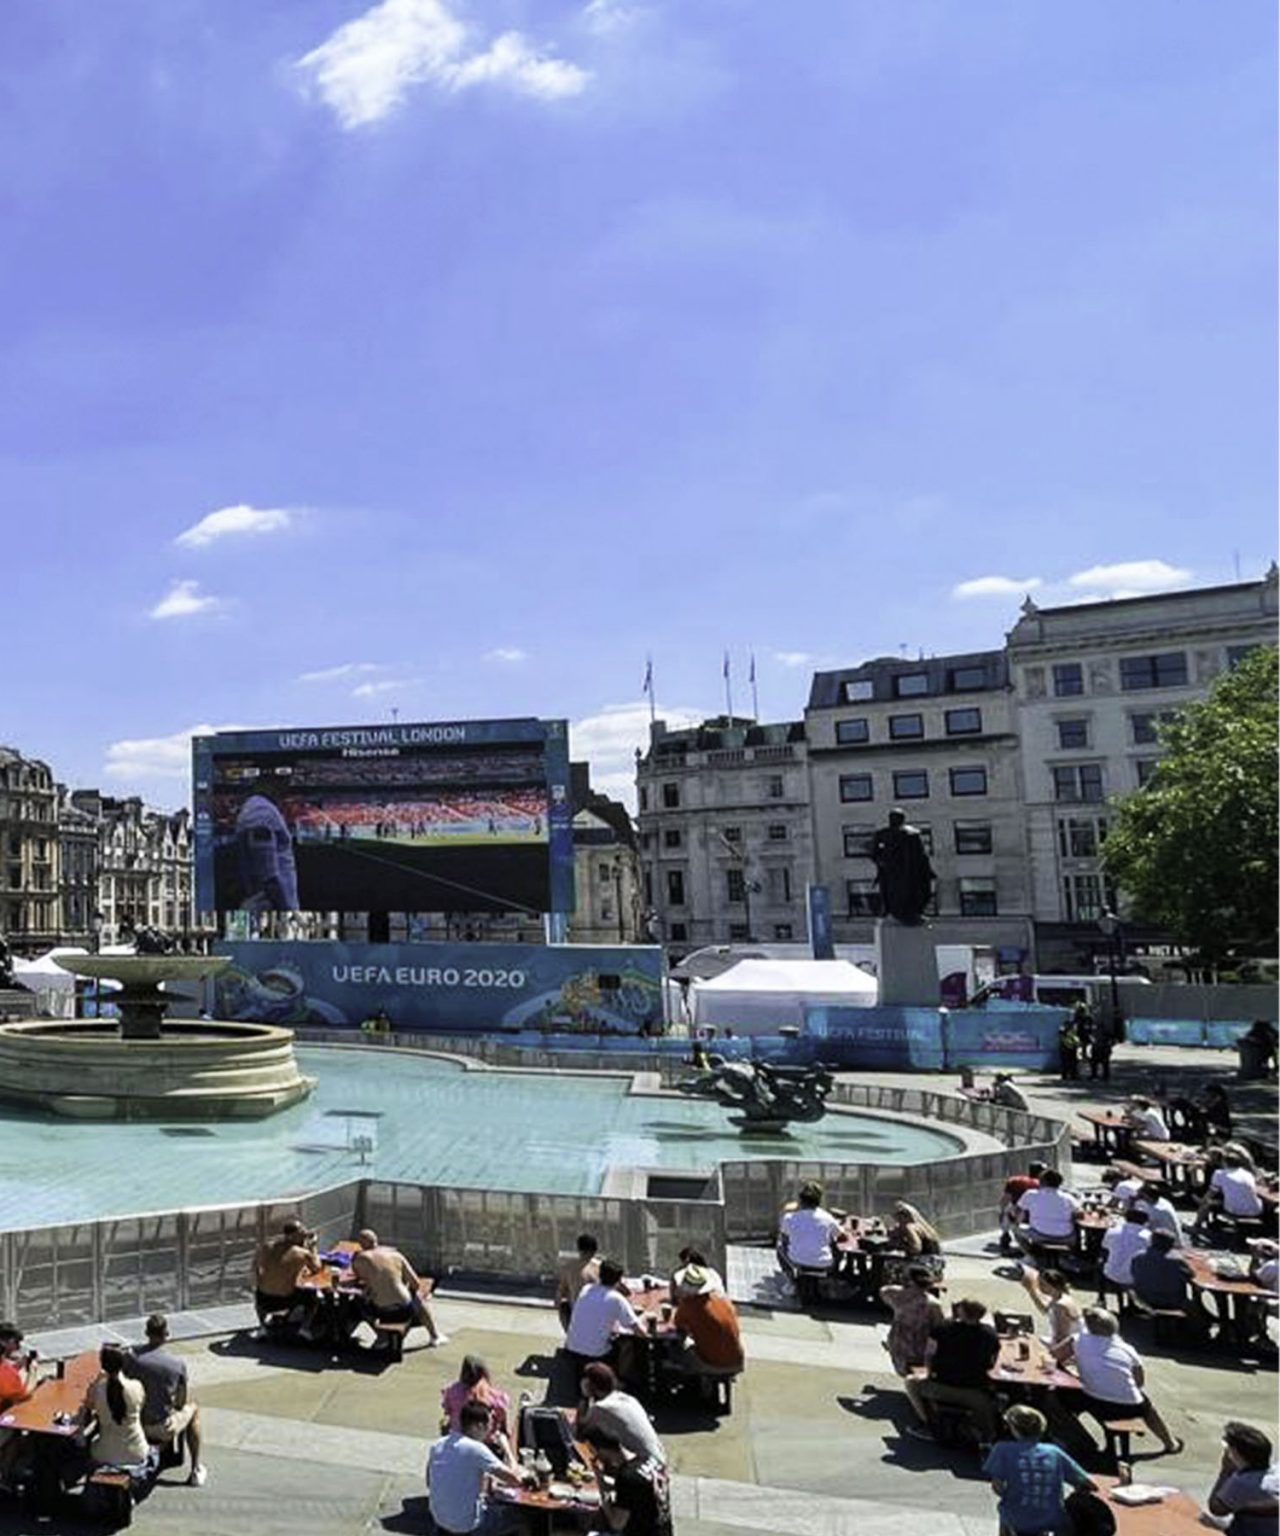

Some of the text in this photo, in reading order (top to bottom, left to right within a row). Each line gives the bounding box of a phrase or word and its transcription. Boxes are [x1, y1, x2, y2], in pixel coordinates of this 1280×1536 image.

[278, 727, 466, 749] UEFA FESTIVAL LONDON
[332, 965, 525, 988] UEFA EURO 2020
